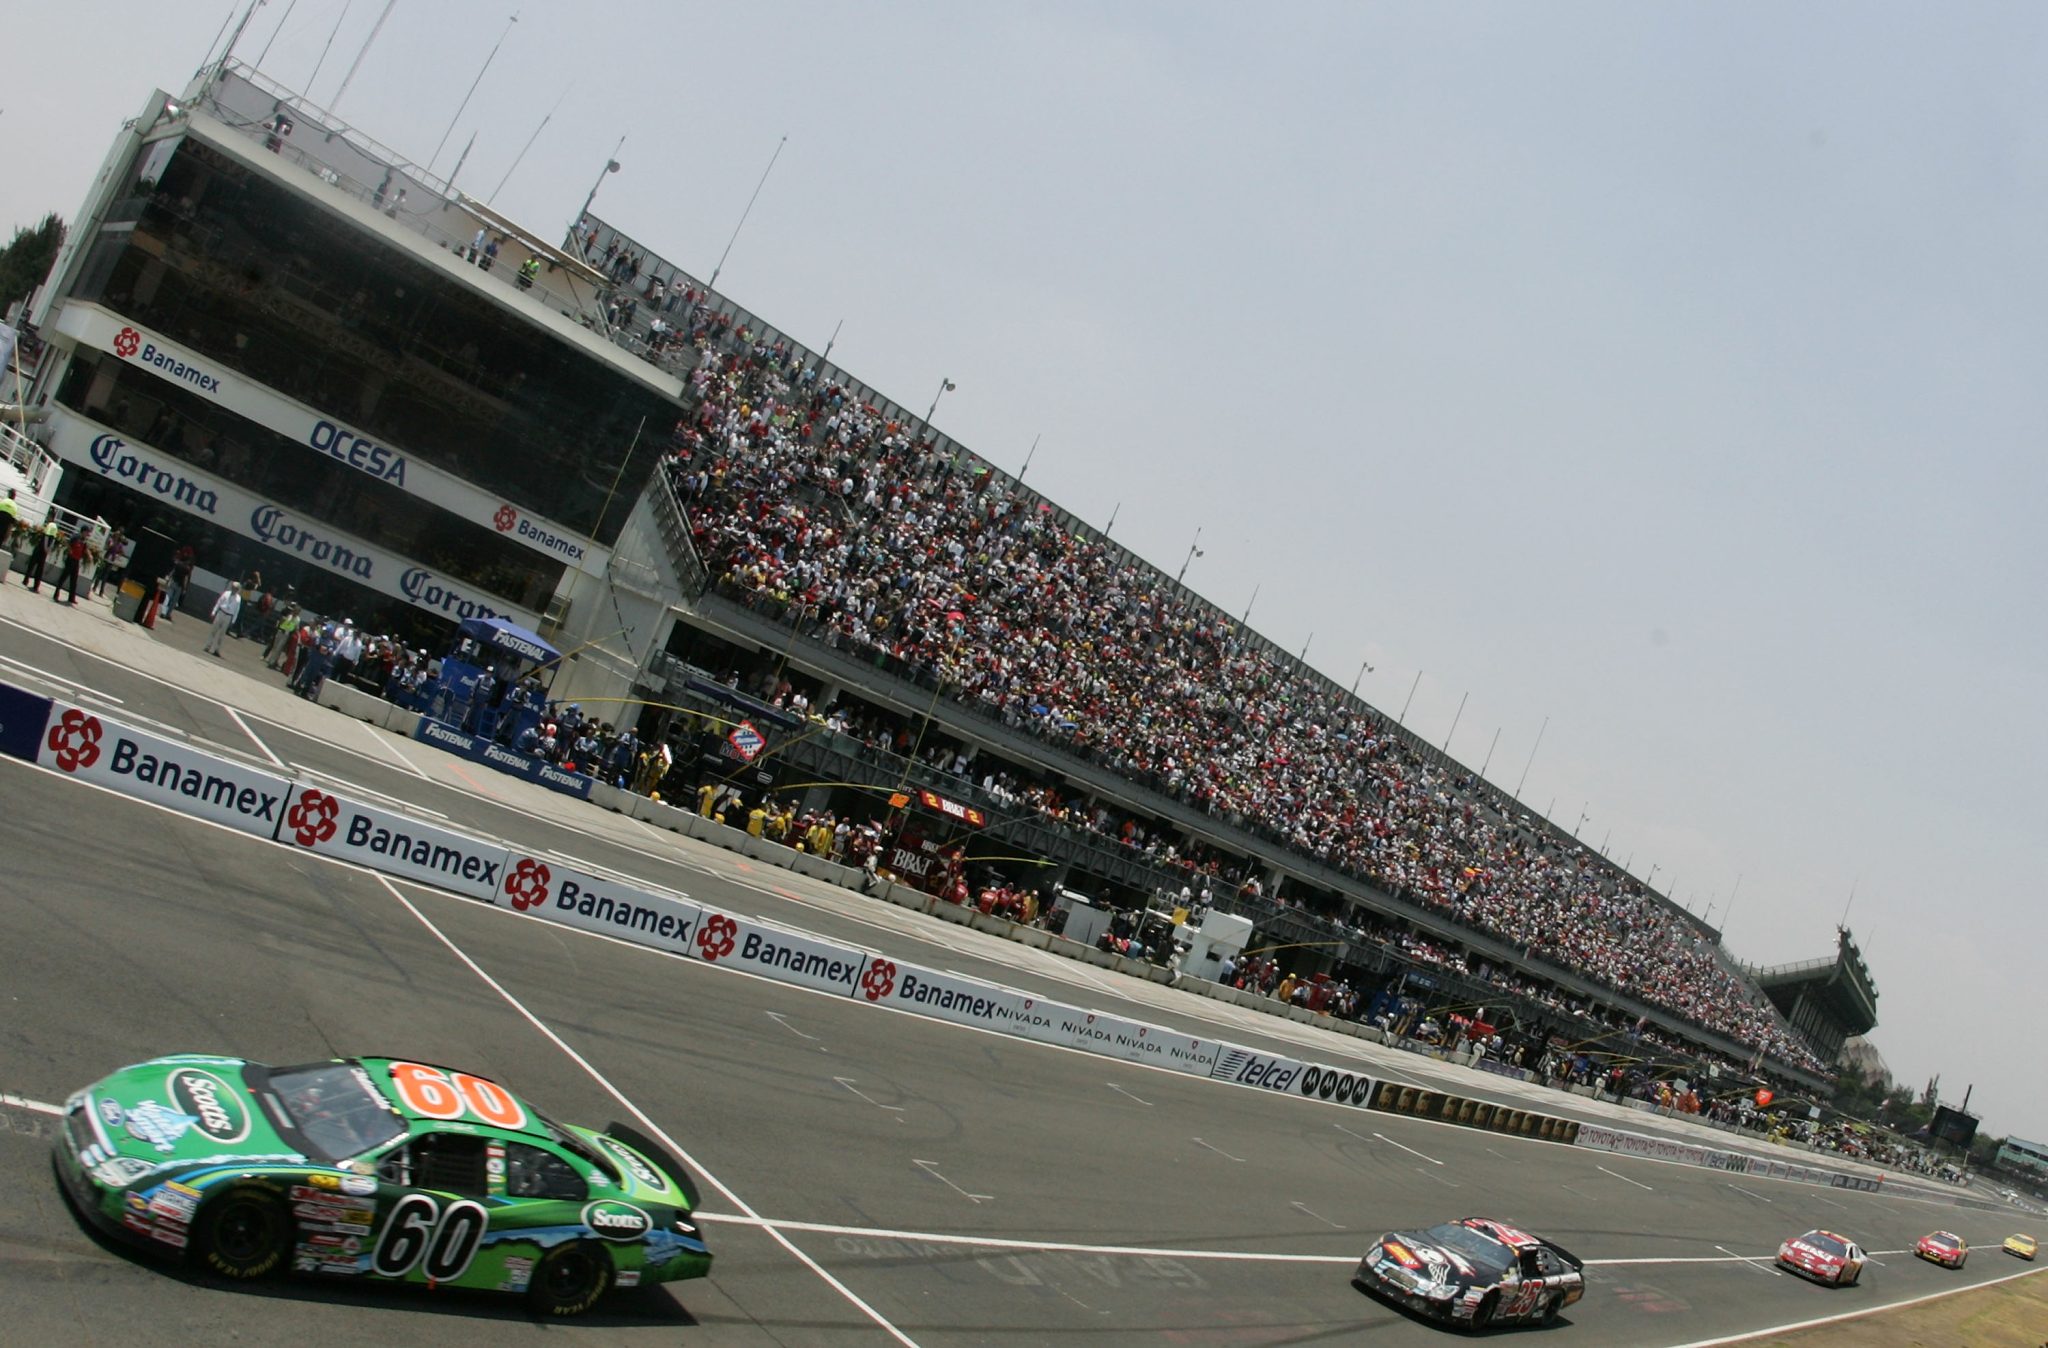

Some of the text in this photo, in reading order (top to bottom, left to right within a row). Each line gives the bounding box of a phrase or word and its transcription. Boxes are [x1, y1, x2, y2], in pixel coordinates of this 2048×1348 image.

[141, 343, 221, 394] Banamex
[310, 420, 407, 487] OCESA
[90, 434, 219, 515] Corona
[251, 504, 374, 580] Corona
[517, 519, 585, 561] Banamex
[493, 627, 546, 661] FASTENAL
[425, 721, 475, 750] FASTENAL
[484, 744, 531, 771] FASTENAL
[110, 738, 279, 822] Banamex
[539, 764, 584, 790] FASTENAL
[346, 814, 500, 886] Banamex
[892, 848, 934, 876] BB&T
[555, 880, 694, 943] Banamex
[741, 934, 858, 985] Banamex
[899, 975, 997, 1020] Banamex
[996, 1006, 1051, 1028] NIVADA
[1061, 1021, 1112, 1042] NIVADA
[1116, 1034, 1162, 1054] NIVADA
[1170, 1047, 1213, 1066] NIVADA
[1236, 1056, 1302, 1091] telcel
[388, 1061, 527, 1130] 60
[1589, 1129, 1615, 1146] TOYOTA
[593, 1208, 644, 1229] Scotts
[371, 1194, 489, 1283] 60
